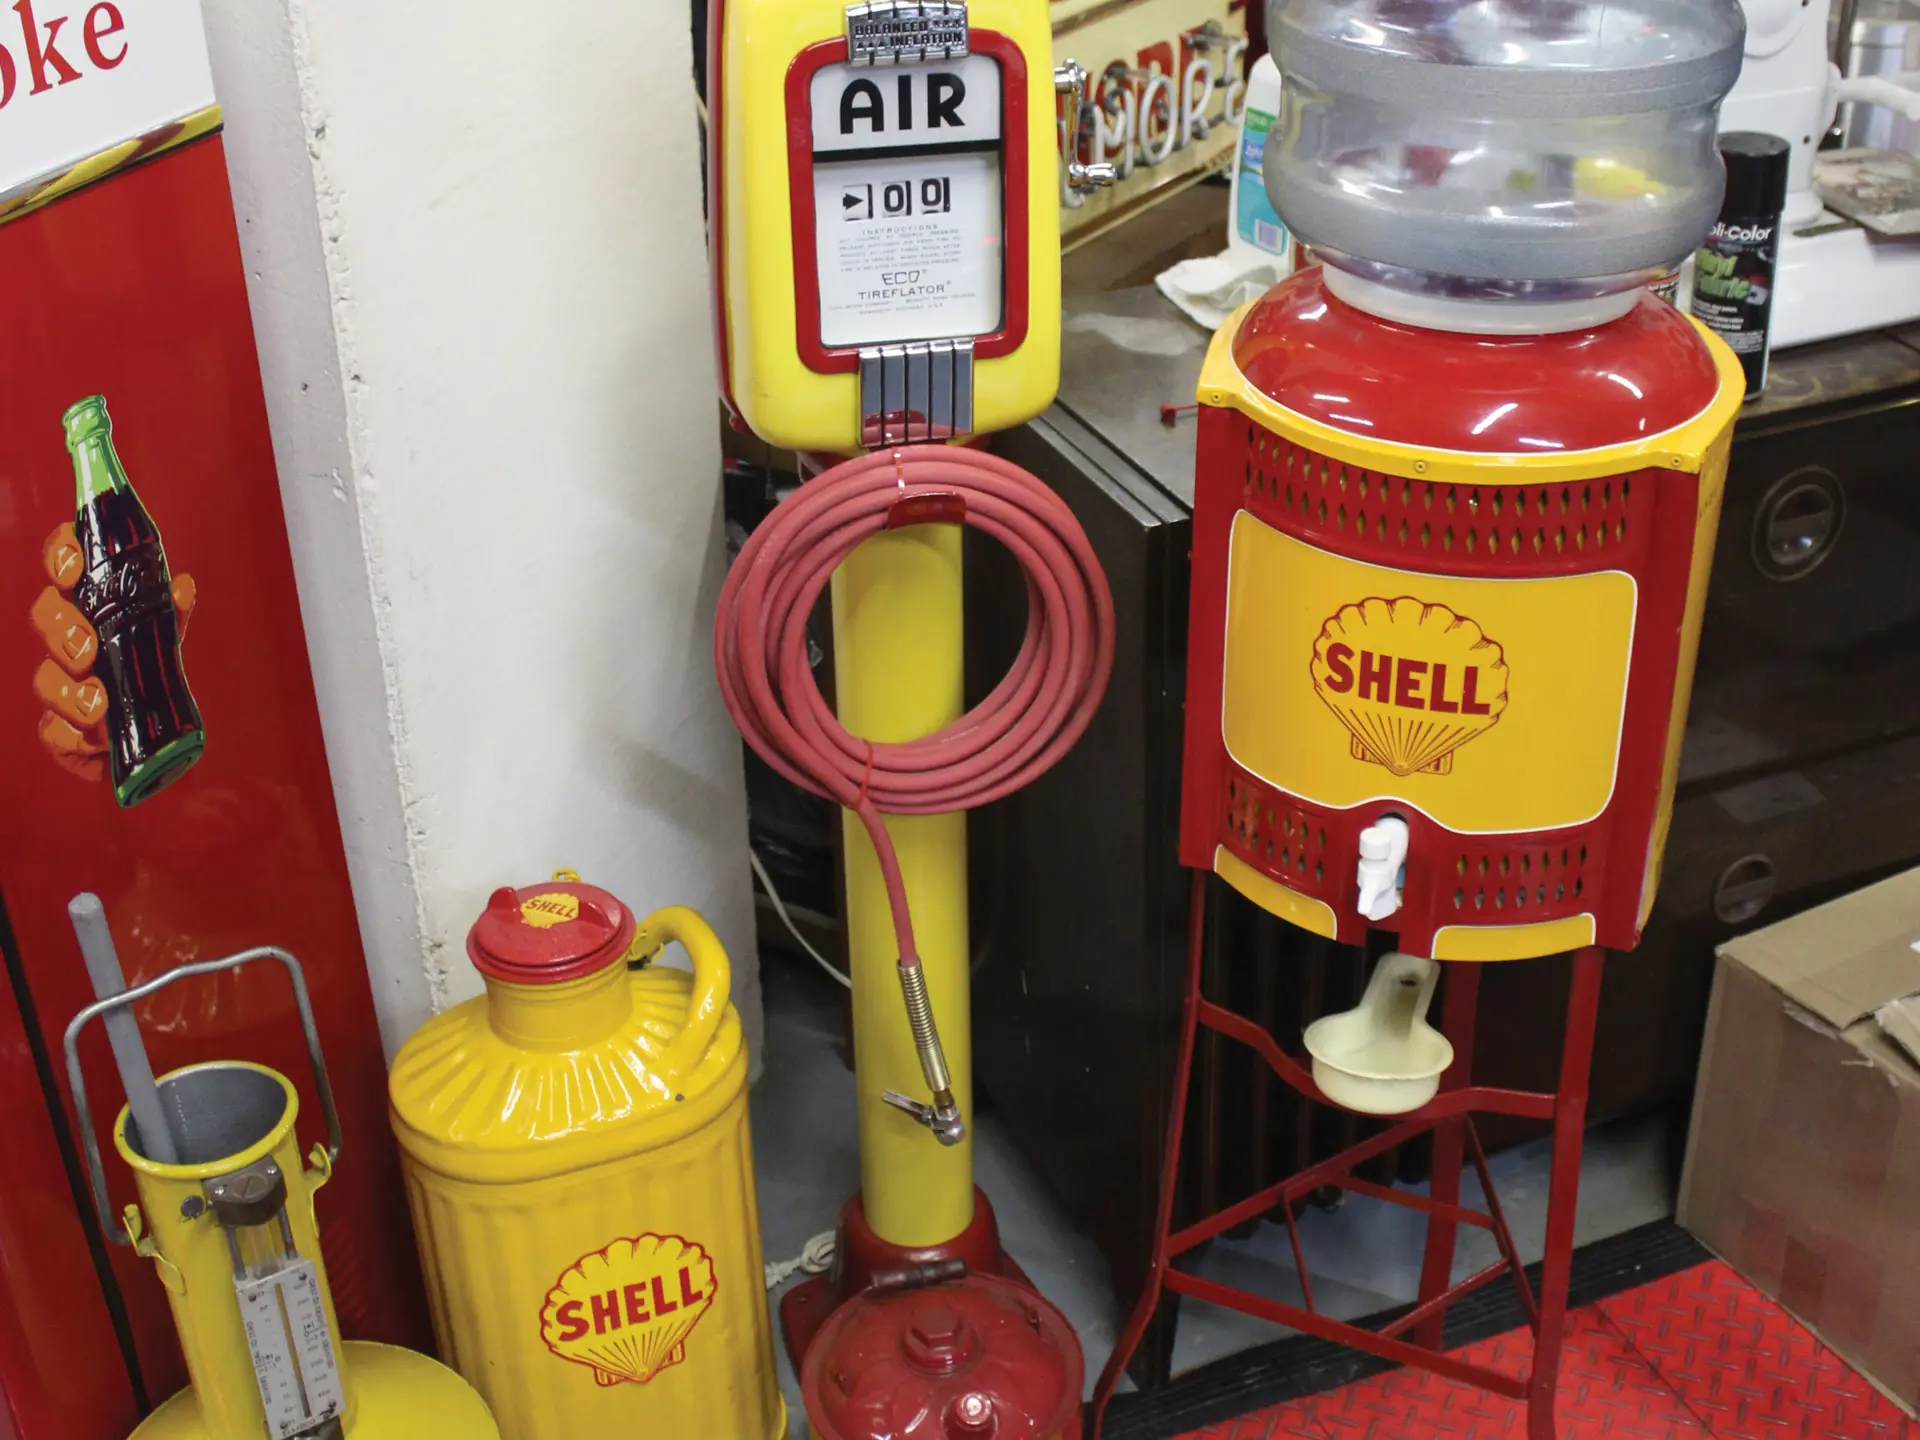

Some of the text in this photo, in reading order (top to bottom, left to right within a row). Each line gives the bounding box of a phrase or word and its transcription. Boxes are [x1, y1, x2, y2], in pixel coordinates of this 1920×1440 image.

[855, 20, 930, 36] BALANCED
[889, 32, 964, 47] INFLATION
[840, 72, 966, 134] AIR
[862, 223, 938, 236] INSTRUCTIONS
[858, 284, 945, 300] TIREFLATOR
[1324, 642, 1491, 715] SHELL
[526, 899, 576, 919] SHELL
[555, 1266, 703, 1342] SHELL
